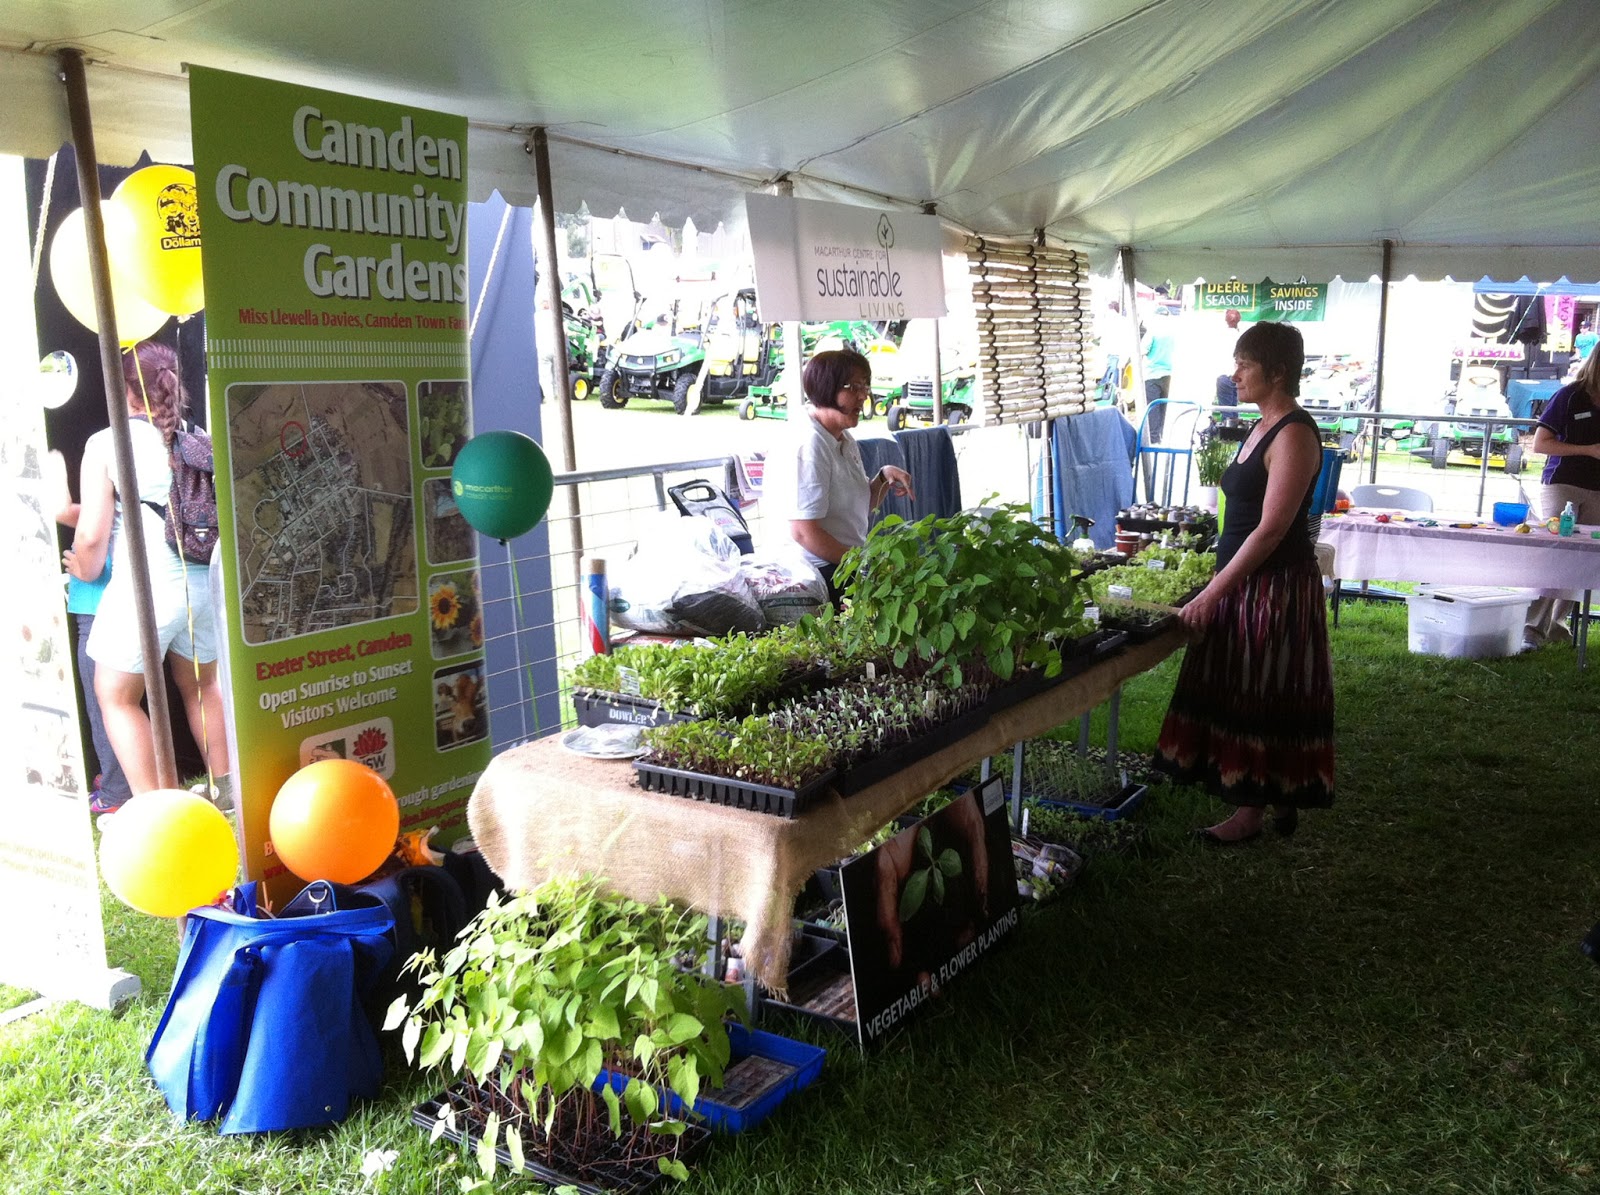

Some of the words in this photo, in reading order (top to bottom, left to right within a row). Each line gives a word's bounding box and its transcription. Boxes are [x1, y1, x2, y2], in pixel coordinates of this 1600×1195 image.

[293, 105, 462, 179] Camden
[215, 164, 465, 254] Community
[814, 246, 851, 258] MACARTHUR
[853, 248, 874, 260] CENTRE
[875, 250, 887, 261] FOR
[303, 243, 468, 303] Gardens
[817, 260, 903, 297] sustainable
[1207, 281, 1249, 293] DEERE
[859, 302, 905, 318] LIVING
[1205, 294, 1249, 306] SEASON
[1270, 287, 1319, 298] SAVINGS
[1275, 299, 1313, 311] INSIDE
[239, 308, 268, 325] Miss
[270, 308, 319, 326] Llewella
[321, 311, 364, 328] Davies,
[365, 312, 412, 329] Camden
[414, 315, 446, 329] Town
[256, 656, 305, 680] Exeter
[307, 644, 356, 668] Street,
[357, 631, 413, 657] Camden
[259, 687, 298, 712] Open
[300, 674, 351, 700] Sunrise
[353, 670, 368, 686] to
[369, 659, 413, 682] Sunset
[281, 702, 335, 729] Visitors
[336, 687, 398, 713] Welcome
[362, 753, 386, 769] SW
[397, 784, 429, 806] rough
[431, 770, 485, 800] gardenin
[866, 979, 929, 1040] VEGETABLE
[931, 973, 939, 992] &
[940, 941, 977, 984] FLOWER
[978, 907, 1018, 953] PLANTING
